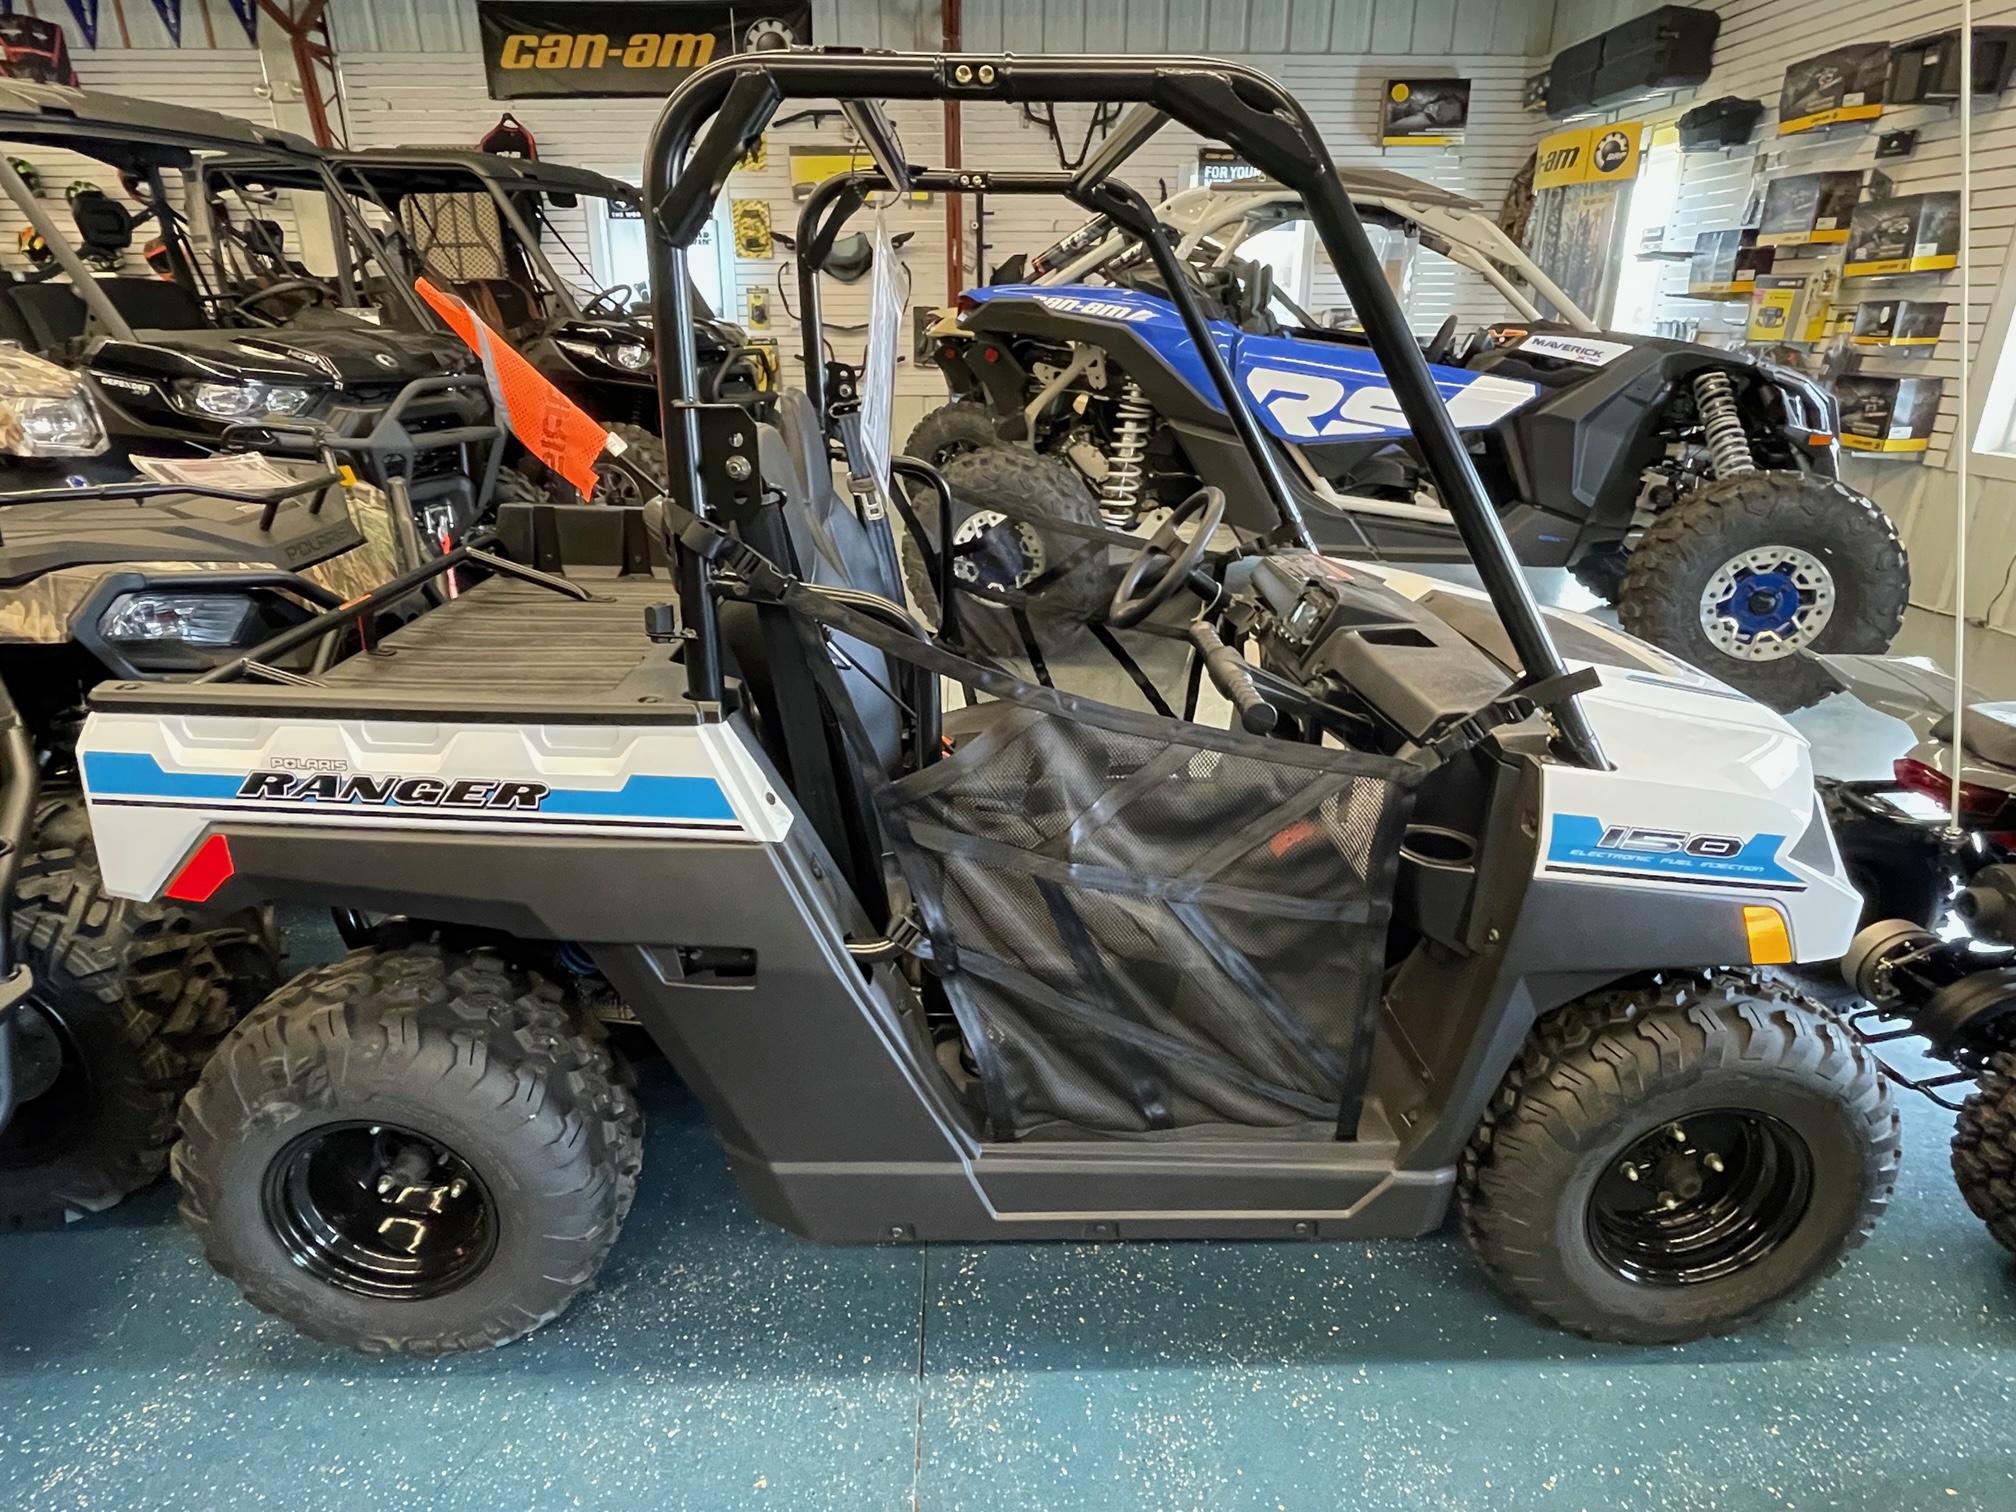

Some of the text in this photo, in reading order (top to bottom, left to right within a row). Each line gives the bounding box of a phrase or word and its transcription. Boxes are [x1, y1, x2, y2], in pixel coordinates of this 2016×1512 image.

[500, 33, 716, 69] can-am
[1204, 165, 1228, 179] FOR
[1531, 337, 1605, 359] MAVERICK
[100, 377, 151, 391] DEFENDER
[270, 756, 349, 772] POLARIS
[236, 769, 550, 811] RANGER
[1595, 824, 1746, 860] 150
[1570, 849, 1765, 873] ELECTRONIC FUEL INJECTION
